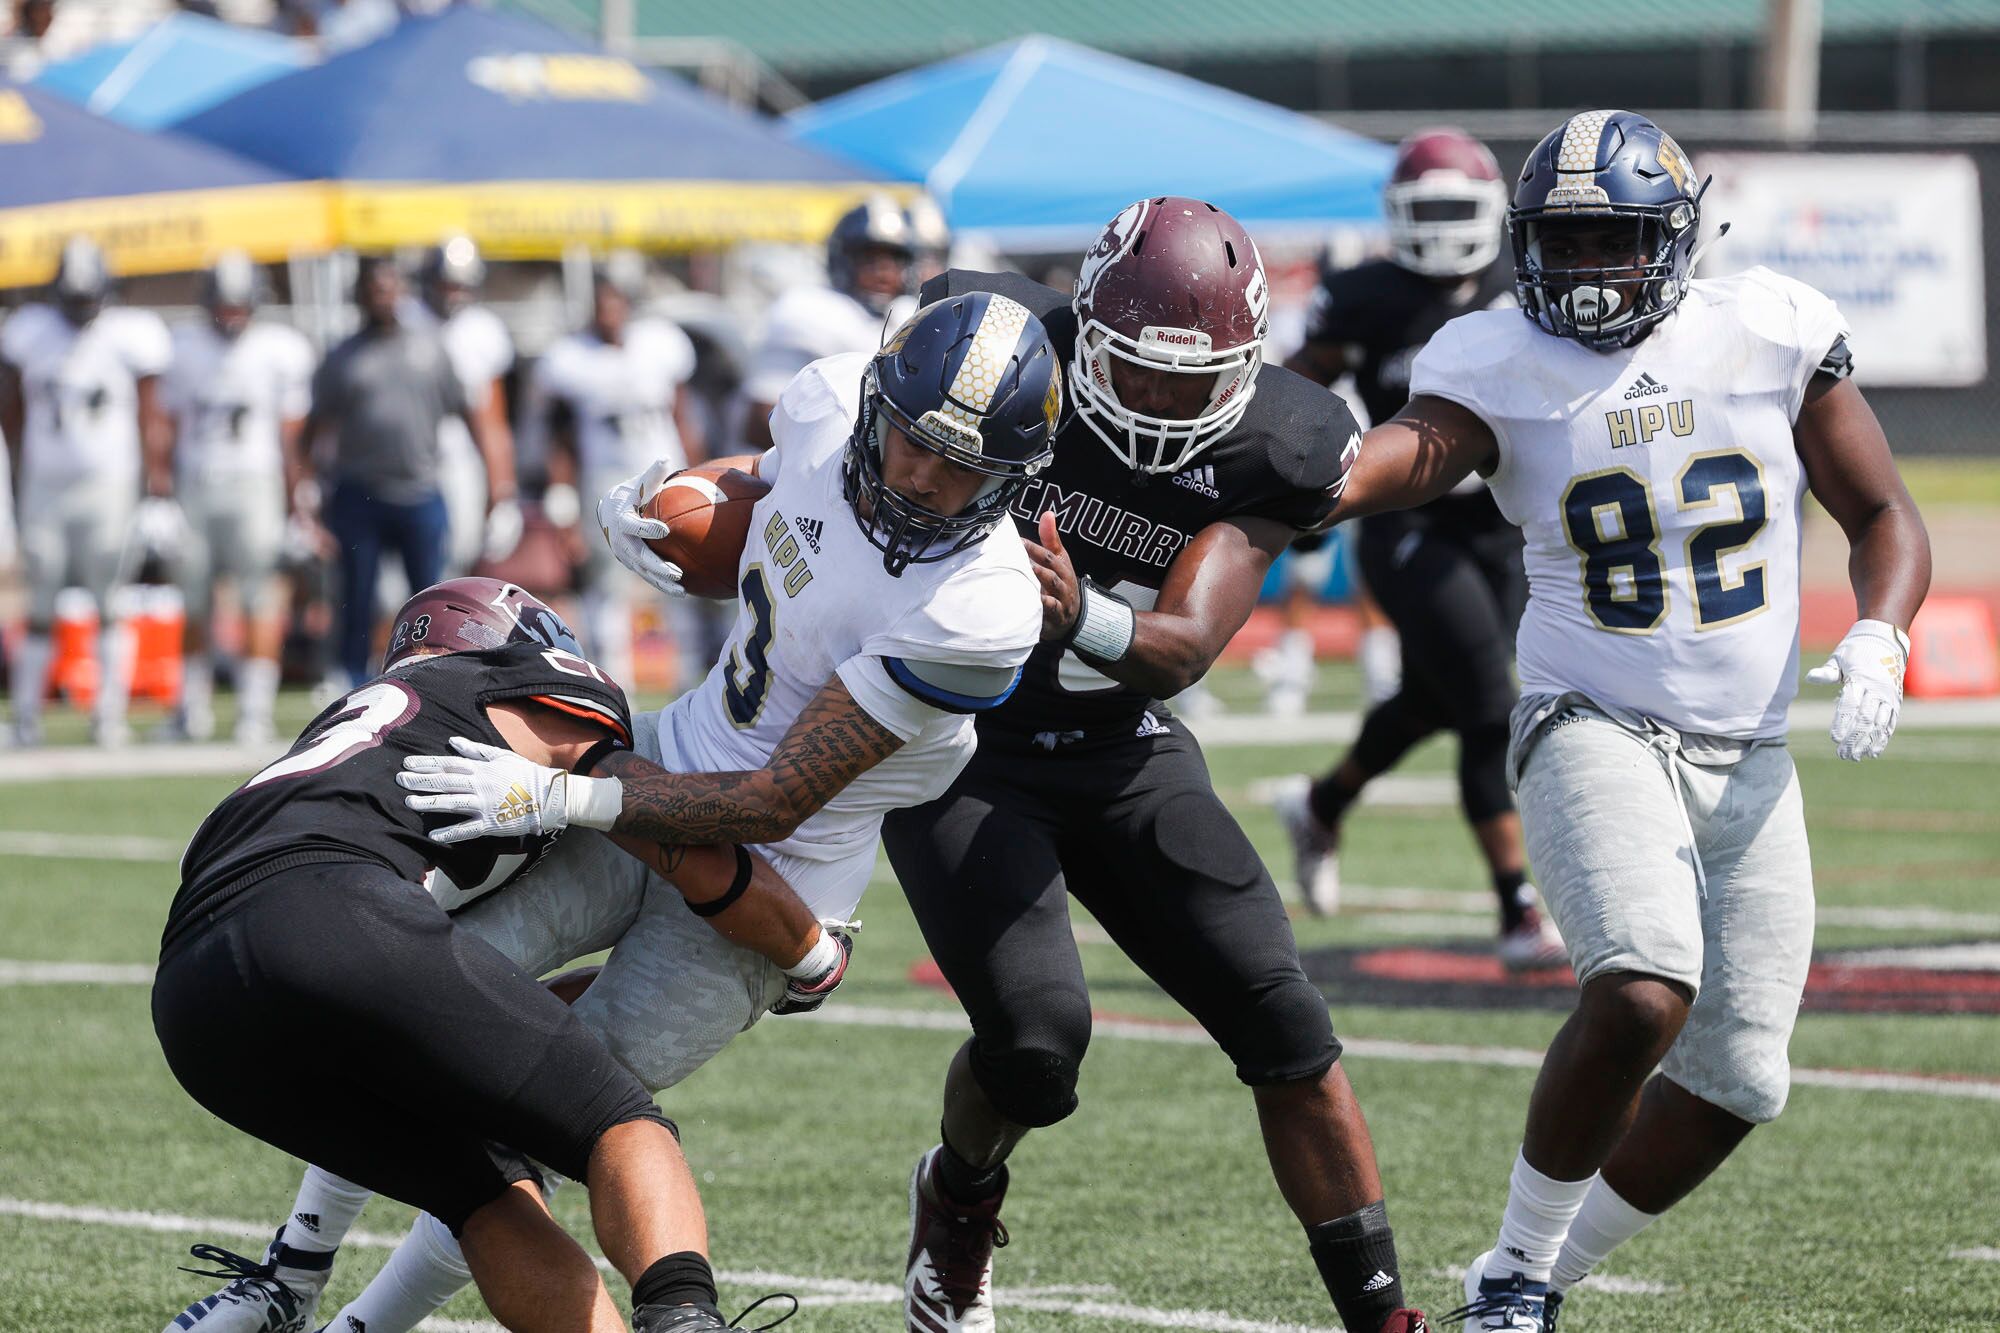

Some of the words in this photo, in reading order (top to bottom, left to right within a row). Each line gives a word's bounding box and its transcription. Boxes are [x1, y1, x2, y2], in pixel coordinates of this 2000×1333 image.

[1156, 330, 1197, 346] Riddell
[1623, 383, 1669, 401] adidas
[1605, 399, 1695, 449] HPU
[1171, 474, 1220, 500] adidas
[795, 516, 822, 555] adidas
[1009, 477, 1194, 568] CMURR
[1558, 446, 1771, 636] 82
[763, 510, 814, 598] HPU
[392, 613, 432, 652] 23
[496, 802, 540, 823] adidas
